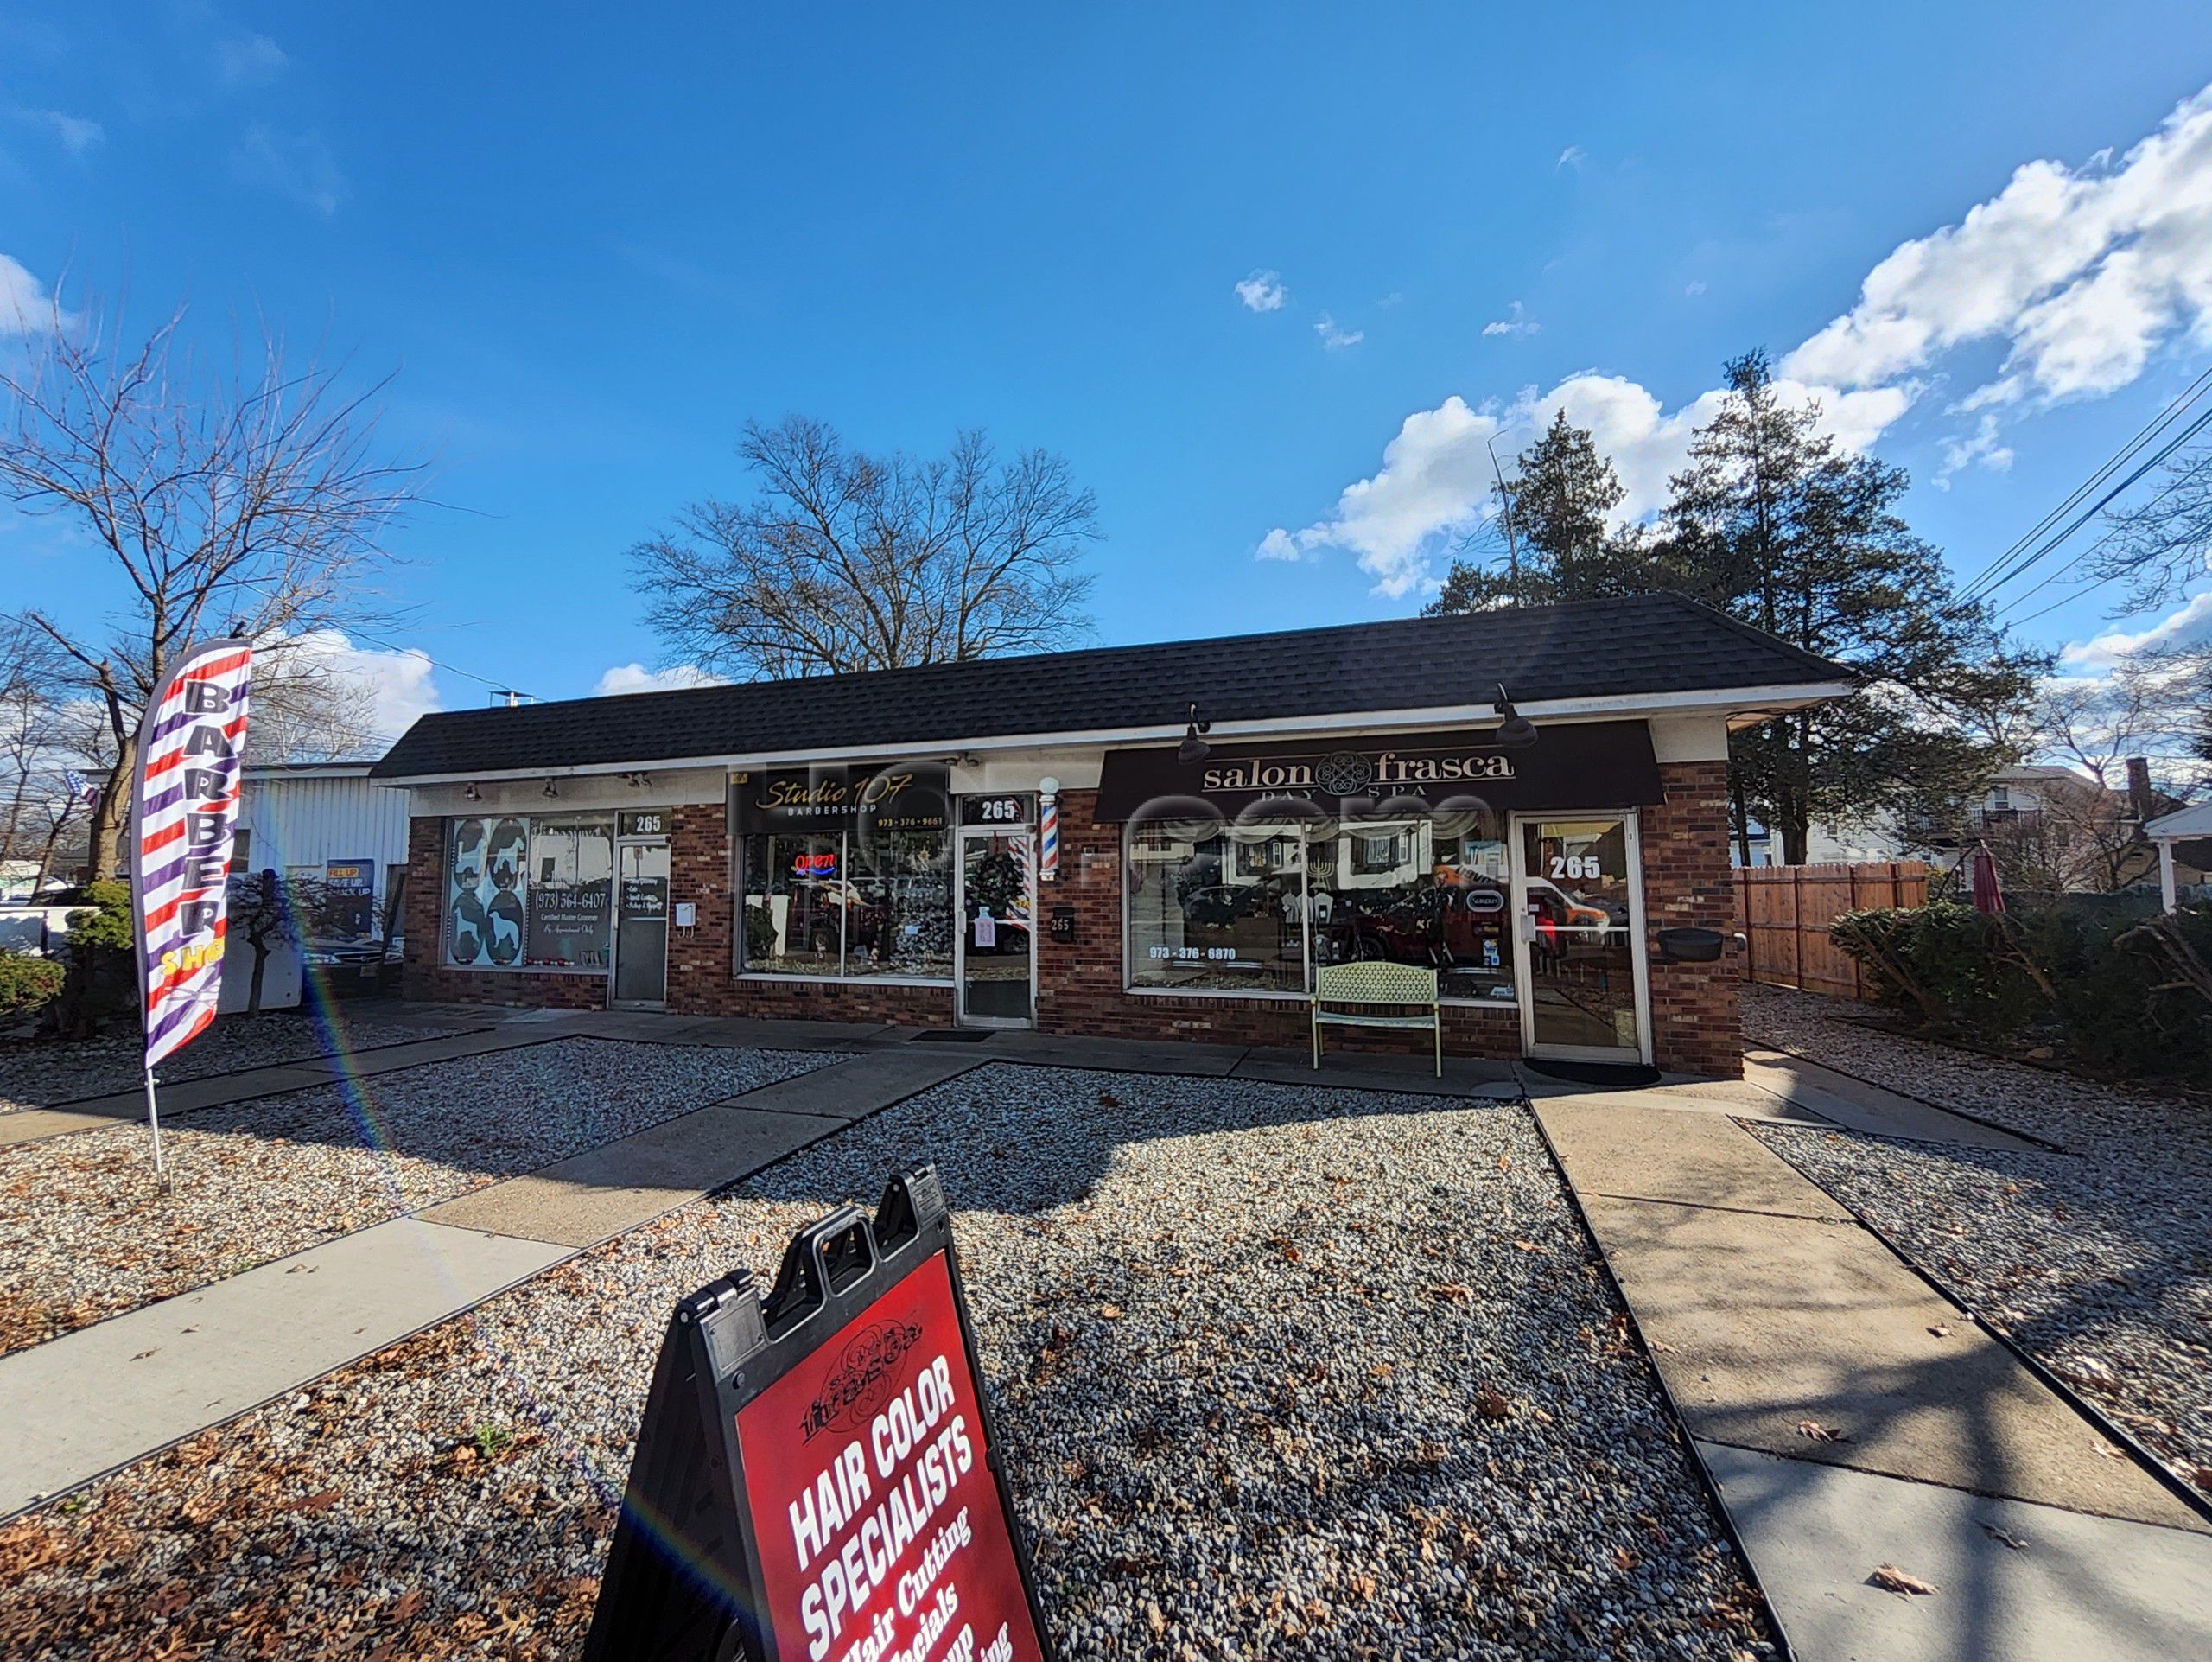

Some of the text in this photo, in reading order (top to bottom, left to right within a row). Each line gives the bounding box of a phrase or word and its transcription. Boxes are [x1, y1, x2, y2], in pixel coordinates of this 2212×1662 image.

[1204, 753, 1515, 789] salon frasca
[755, 774, 912, 809] Studio 107
[1262, 784, 1427, 803] DAY SPA
[181, 680, 236, 937] BARBER
[788, 805, 877, 817] BARBERSHOP
[982, 801, 1014, 819] 265
[636, 815, 661, 831] 265
[1550, 856, 1600, 879] 265
[535, 892, 558, 910] (973)
[1052, 918, 1069, 931] 265
[789, 1354, 955, 1572] HAIR COLOR
[801, 1415, 972, 1661] SPECIALISTS
[898, 1506, 971, 1617] Cutting
